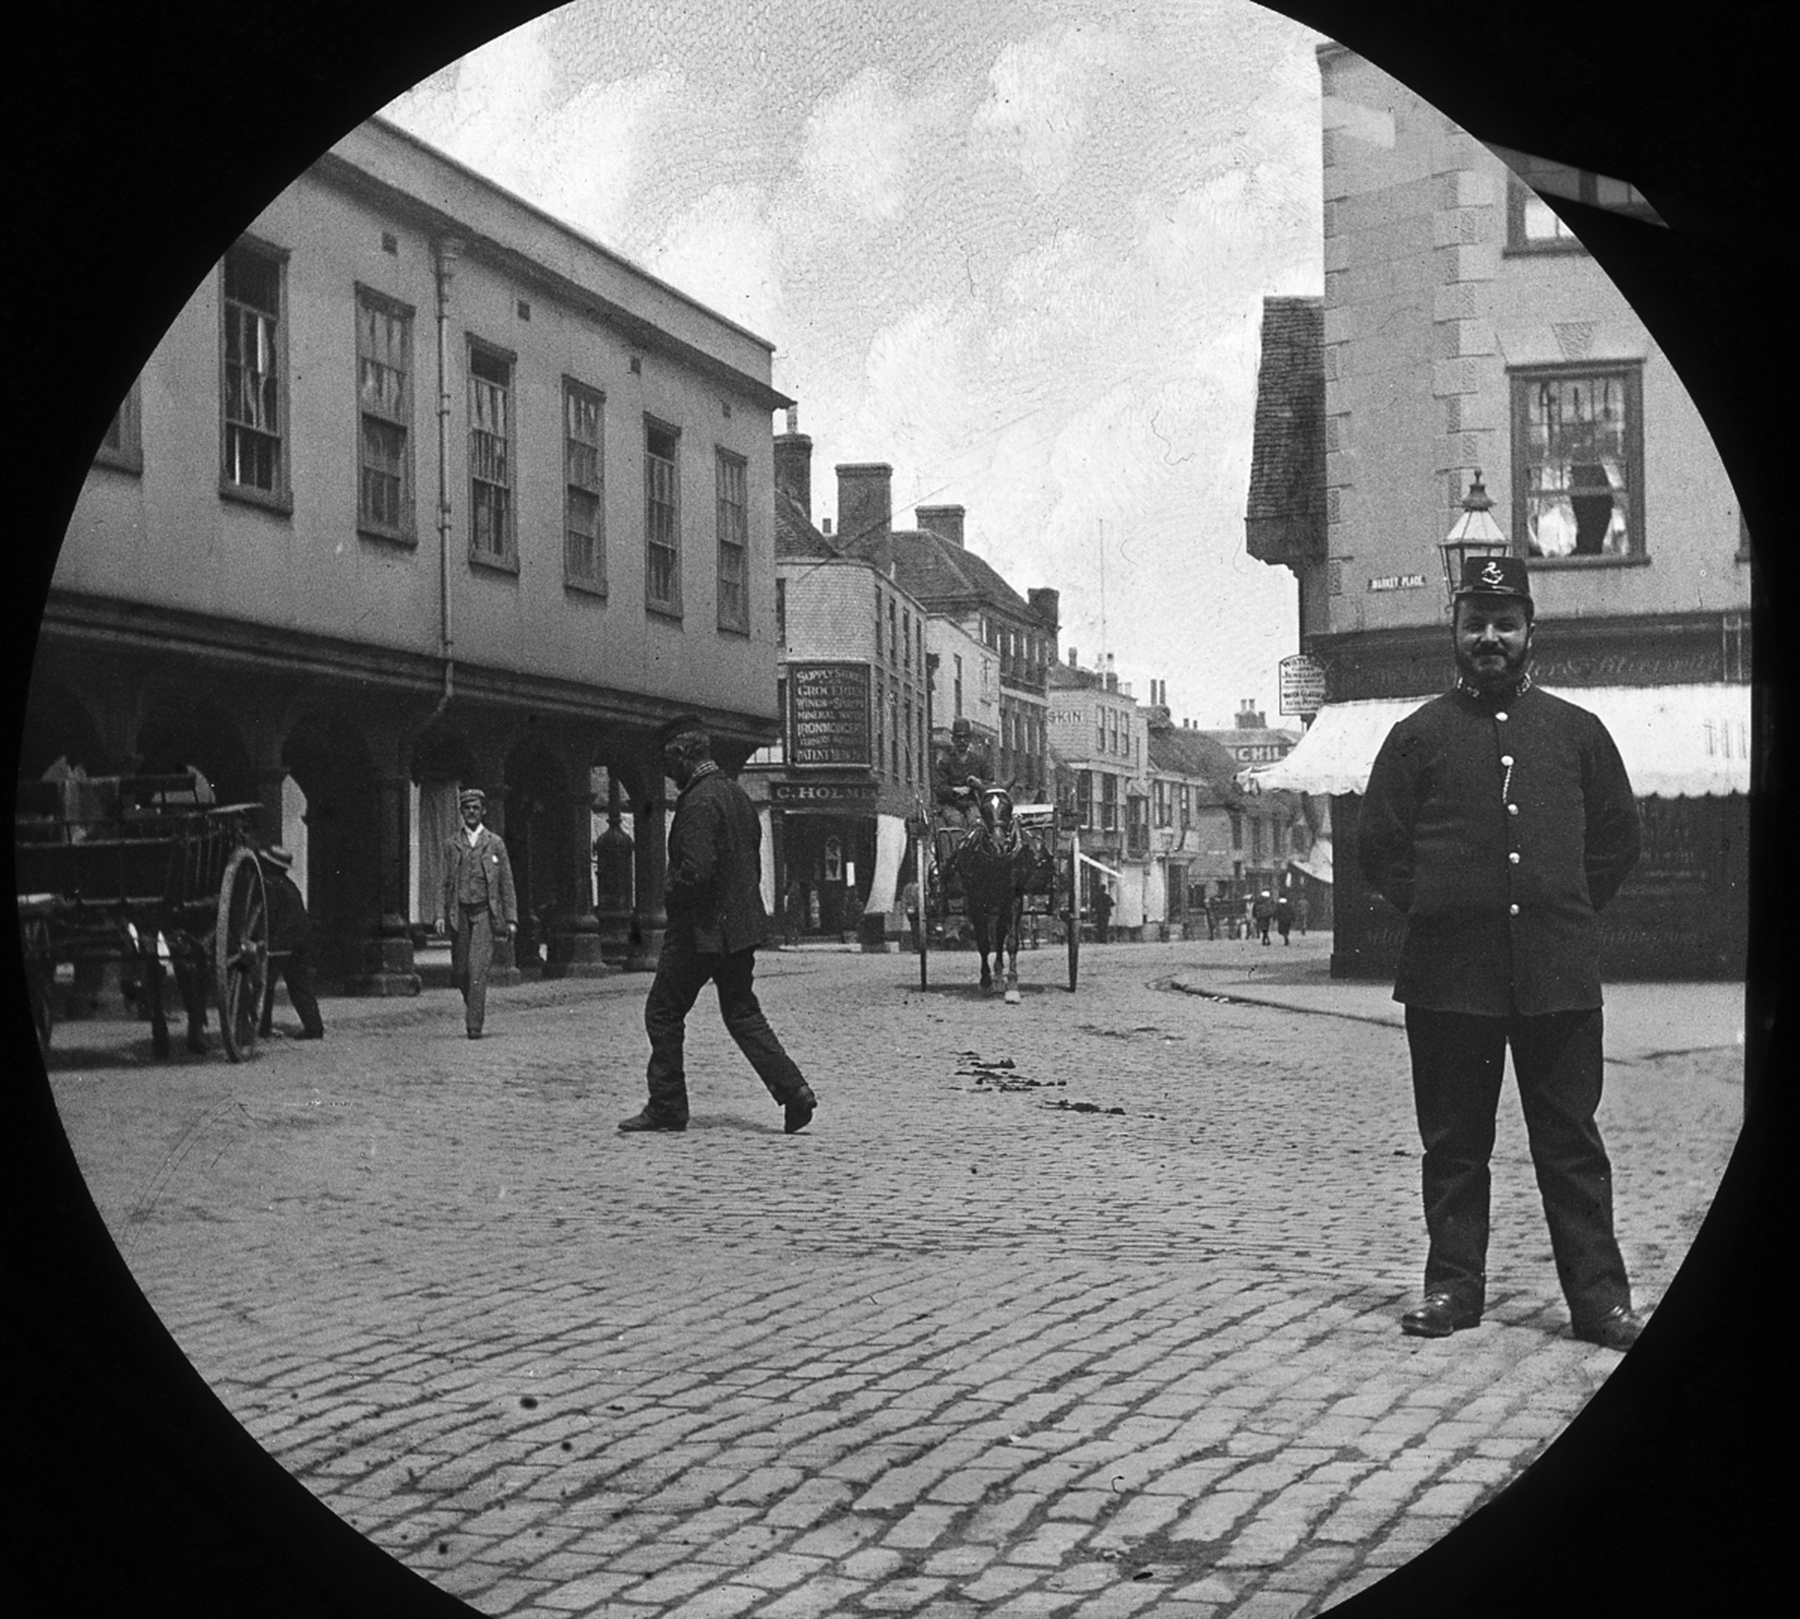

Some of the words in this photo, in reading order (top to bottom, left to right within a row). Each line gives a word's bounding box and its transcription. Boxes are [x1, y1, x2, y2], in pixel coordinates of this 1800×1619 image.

[1371, 577, 1398, 589] MARKET
[1401, 575, 1424, 587] PLACE
[797, 669, 833, 683] SUPPLY
[797, 685, 864, 696] GROCERIES
[796, 698, 828, 710] WINES
[797, 710, 837, 720] MINERAL
[797, 749, 829, 761] PATENT
